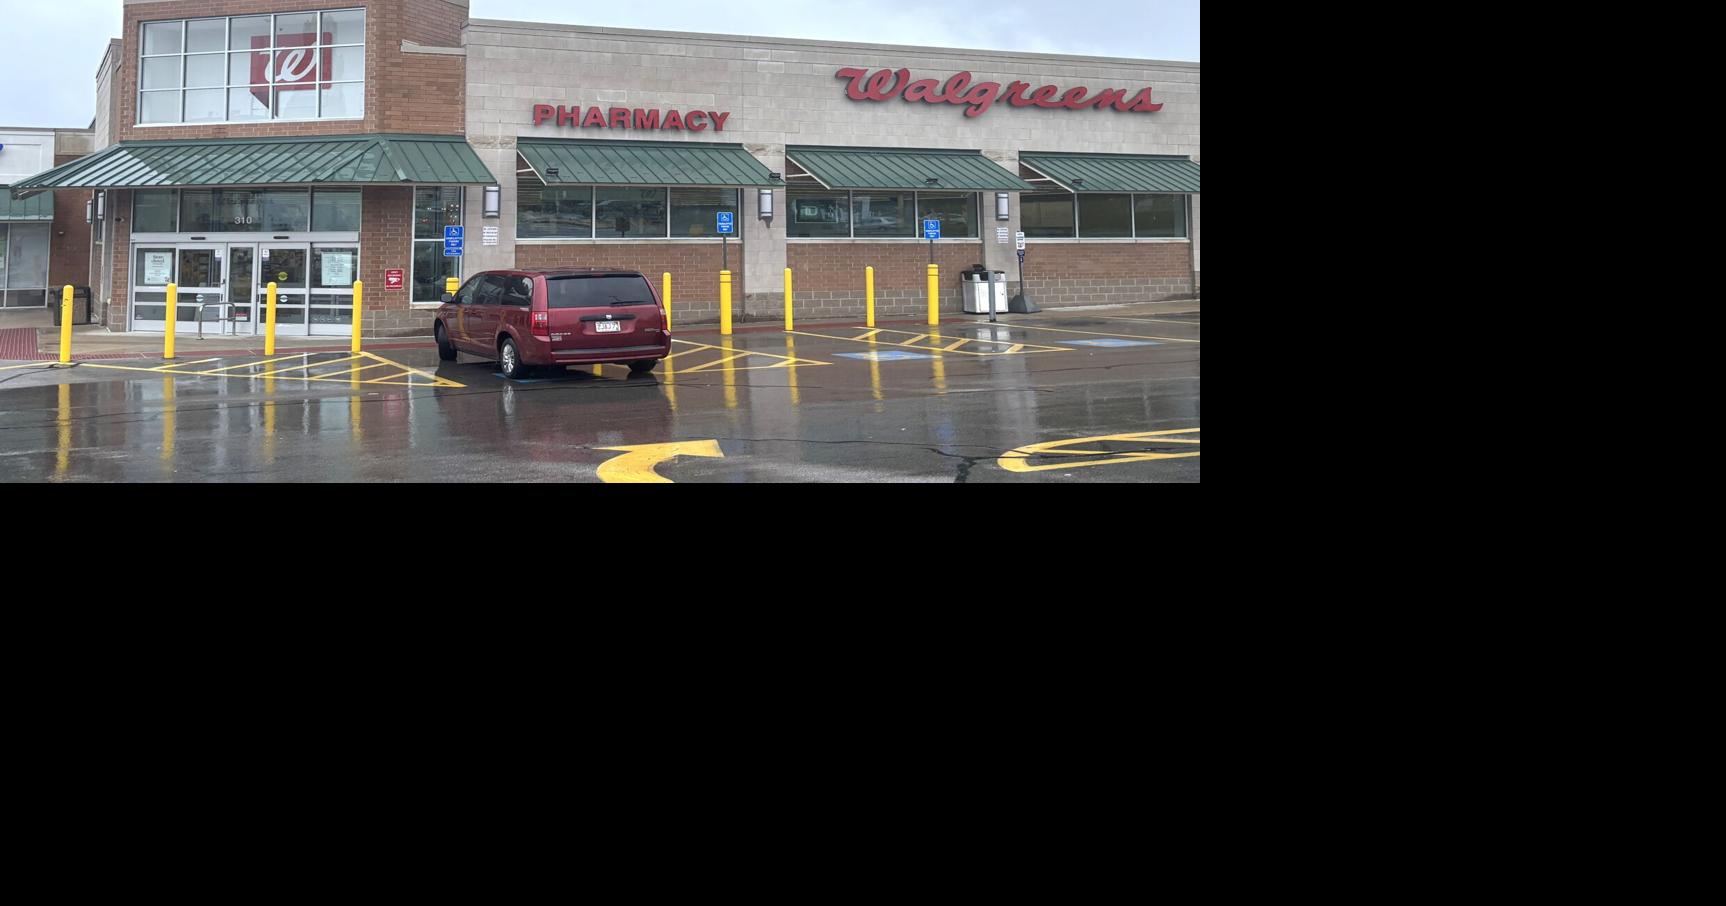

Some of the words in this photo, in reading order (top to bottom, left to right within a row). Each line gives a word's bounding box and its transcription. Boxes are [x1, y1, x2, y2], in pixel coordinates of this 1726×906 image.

[835, 67, 1163, 118] Walgreens
[533, 104, 731, 132] PHARMACY
[234, 216, 253, 225] 310
